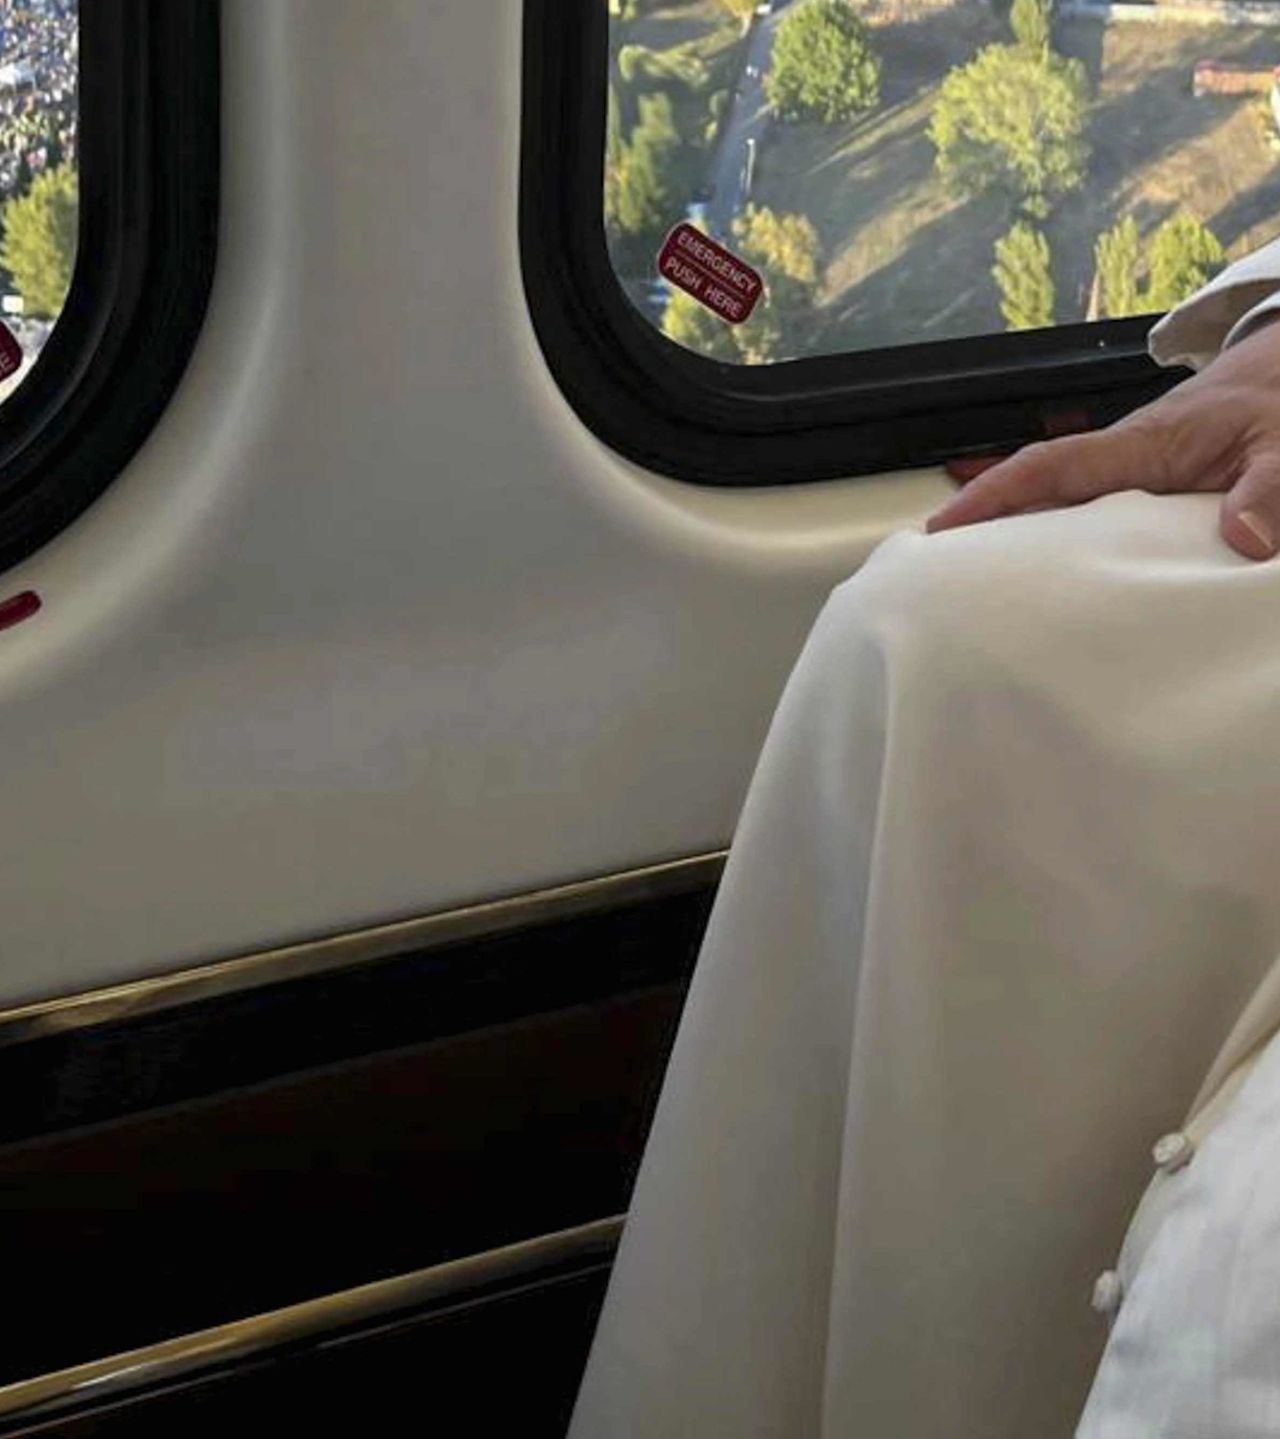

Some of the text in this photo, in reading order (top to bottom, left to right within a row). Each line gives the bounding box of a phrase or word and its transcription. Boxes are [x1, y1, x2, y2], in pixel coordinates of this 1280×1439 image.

[664, 256, 742, 318] PUSH HERE
[677, 232, 757, 291] EMERGENCY
